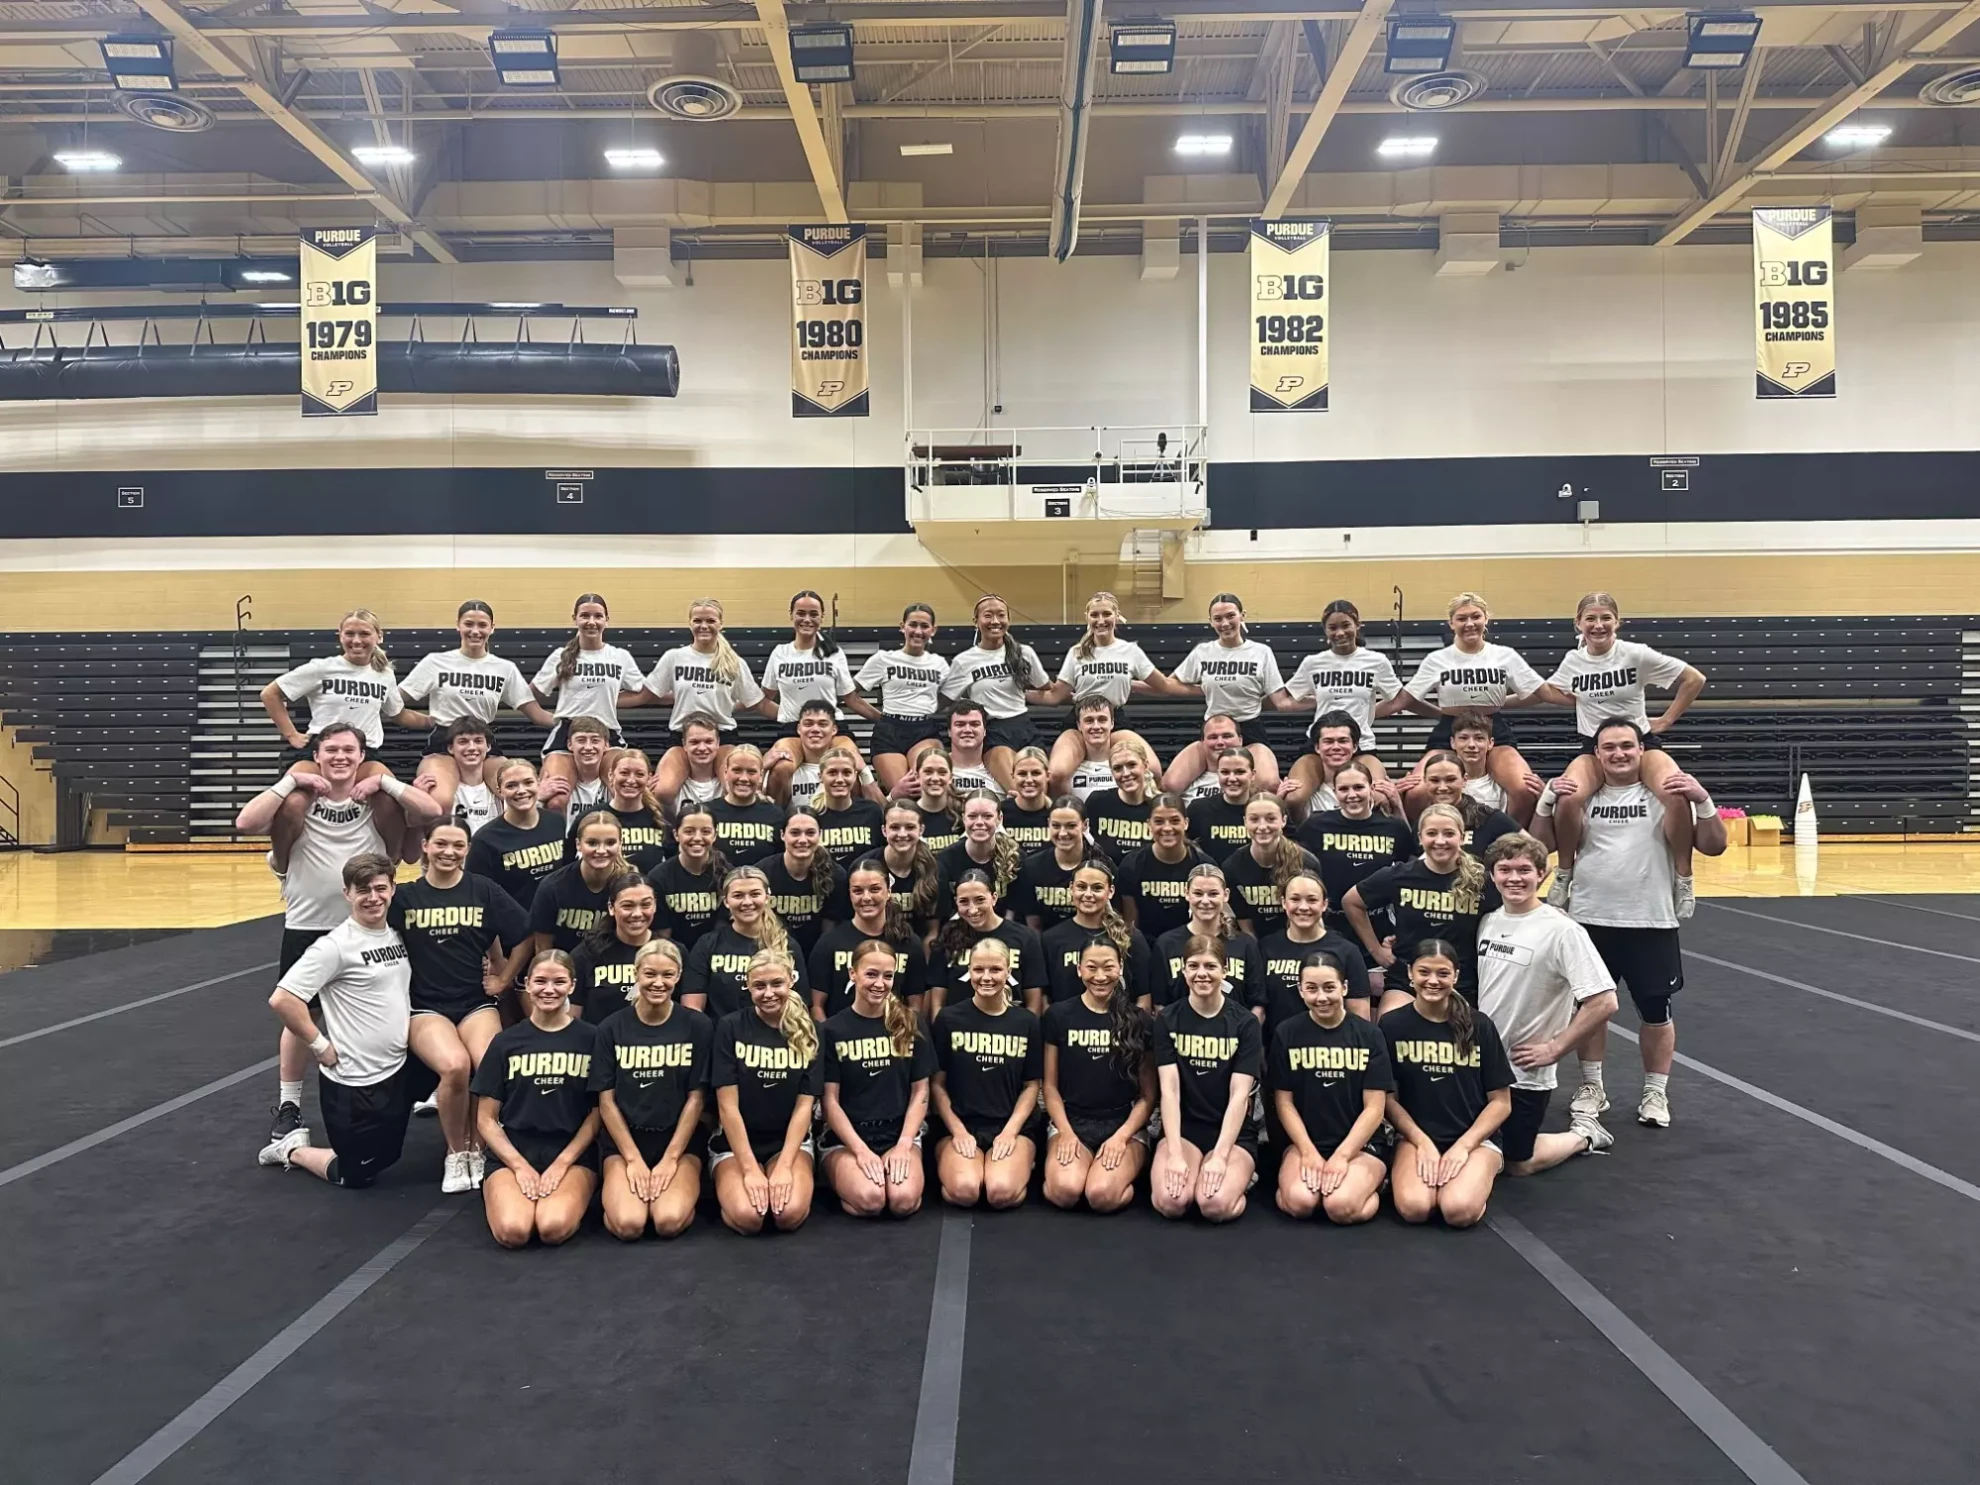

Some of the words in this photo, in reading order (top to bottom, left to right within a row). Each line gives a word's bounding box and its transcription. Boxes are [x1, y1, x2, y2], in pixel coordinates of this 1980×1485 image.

[1768, 208, 1816, 222] PURDUE
[315, 229, 361, 243] PURDUE
[804, 227, 851, 240] PURDUE
[1266, 223, 1314, 236] PURDUE
[1760, 301, 1828, 330] 1985
[306, 320, 372, 349] 1979
[796, 319, 862, 348] 1980
[1256, 315, 1323, 343] 1982
[1765, 331, 1824, 342] CHAMPIONS
[311, 350, 367, 361] CHAMPIONS
[801, 350, 858, 361] CHAMPIONS
[1260, 345, 1319, 356] CHAMPIONS
[1672, 479, 1679, 487] 2
[127, 496, 134, 504] 5
[566, 492, 574, 500] 4
[1054, 507, 1062, 515] 3
[574, 663, 622, 681] URDUE
[778, 662, 833, 678] PURDUE
[886, 666, 941, 685] PURDUE
[1081, 662, 1128, 676] PURDUE
[1201, 661, 1258, 676] PURDUE
[438, 672, 505, 693] PURDUE
[1313, 670, 1374, 689] PURDUE
[1440, 668, 1506, 686] PURDUE
[1571, 668, 1637, 693] PURDUE
[322, 678, 387, 701] PURDUE
[1589, 690, 1615, 698] CHEER
[345, 696, 370, 704] CHEER
[952, 777, 986, 788] RDUE
[312, 804, 360, 824] PURDUE
[1591, 805, 1647, 819] PURDUE
[716, 822, 774, 842] URDUE
[1006, 827, 1050, 842] PURDU
[1098, 817, 1153, 841] PURDU
[1210, 825, 1251, 839] PURD
[621, 827, 663, 847] RDUE
[729, 839, 755, 847] CHEER
[819, 827, 871, 846] URDUE
[829, 846, 854, 854] CHEER
[1323, 833, 1395, 855] PURDUE
[1346, 852, 1374, 860] CHEER
[530, 864, 554, 875] CHEER
[1141, 881, 1187, 897] PURDU
[405, 906, 484, 930] PURDUE
[1424, 911, 1454, 920] CHEER
[429, 927, 459, 936] CHEER
[361, 944, 408, 966] PURDUE
[1490, 943, 1515, 955] PURDUE
[711, 954, 752, 973] PUR
[594, 964, 635, 988] PUR
[951, 1031, 1028, 1058] PURDUE
[735, 1041, 809, 1069] PURDU
[976, 1055, 1005, 1065] CHEER
[1288, 1046, 1370, 1071] PURDUE
[508, 1052, 592, 1080] PURDUE
[862, 1059, 891, 1069] CHEER
[1190, 1058, 1218, 1068] CHEER
[1422, 1064, 1454, 1074] CHEER
[534, 1077, 564, 1085] CHEER
[633, 1070, 664, 1079] CHEER
[757, 1070, 788, 1079] CHEER
[1315, 1070, 1345, 1078] CHEER
